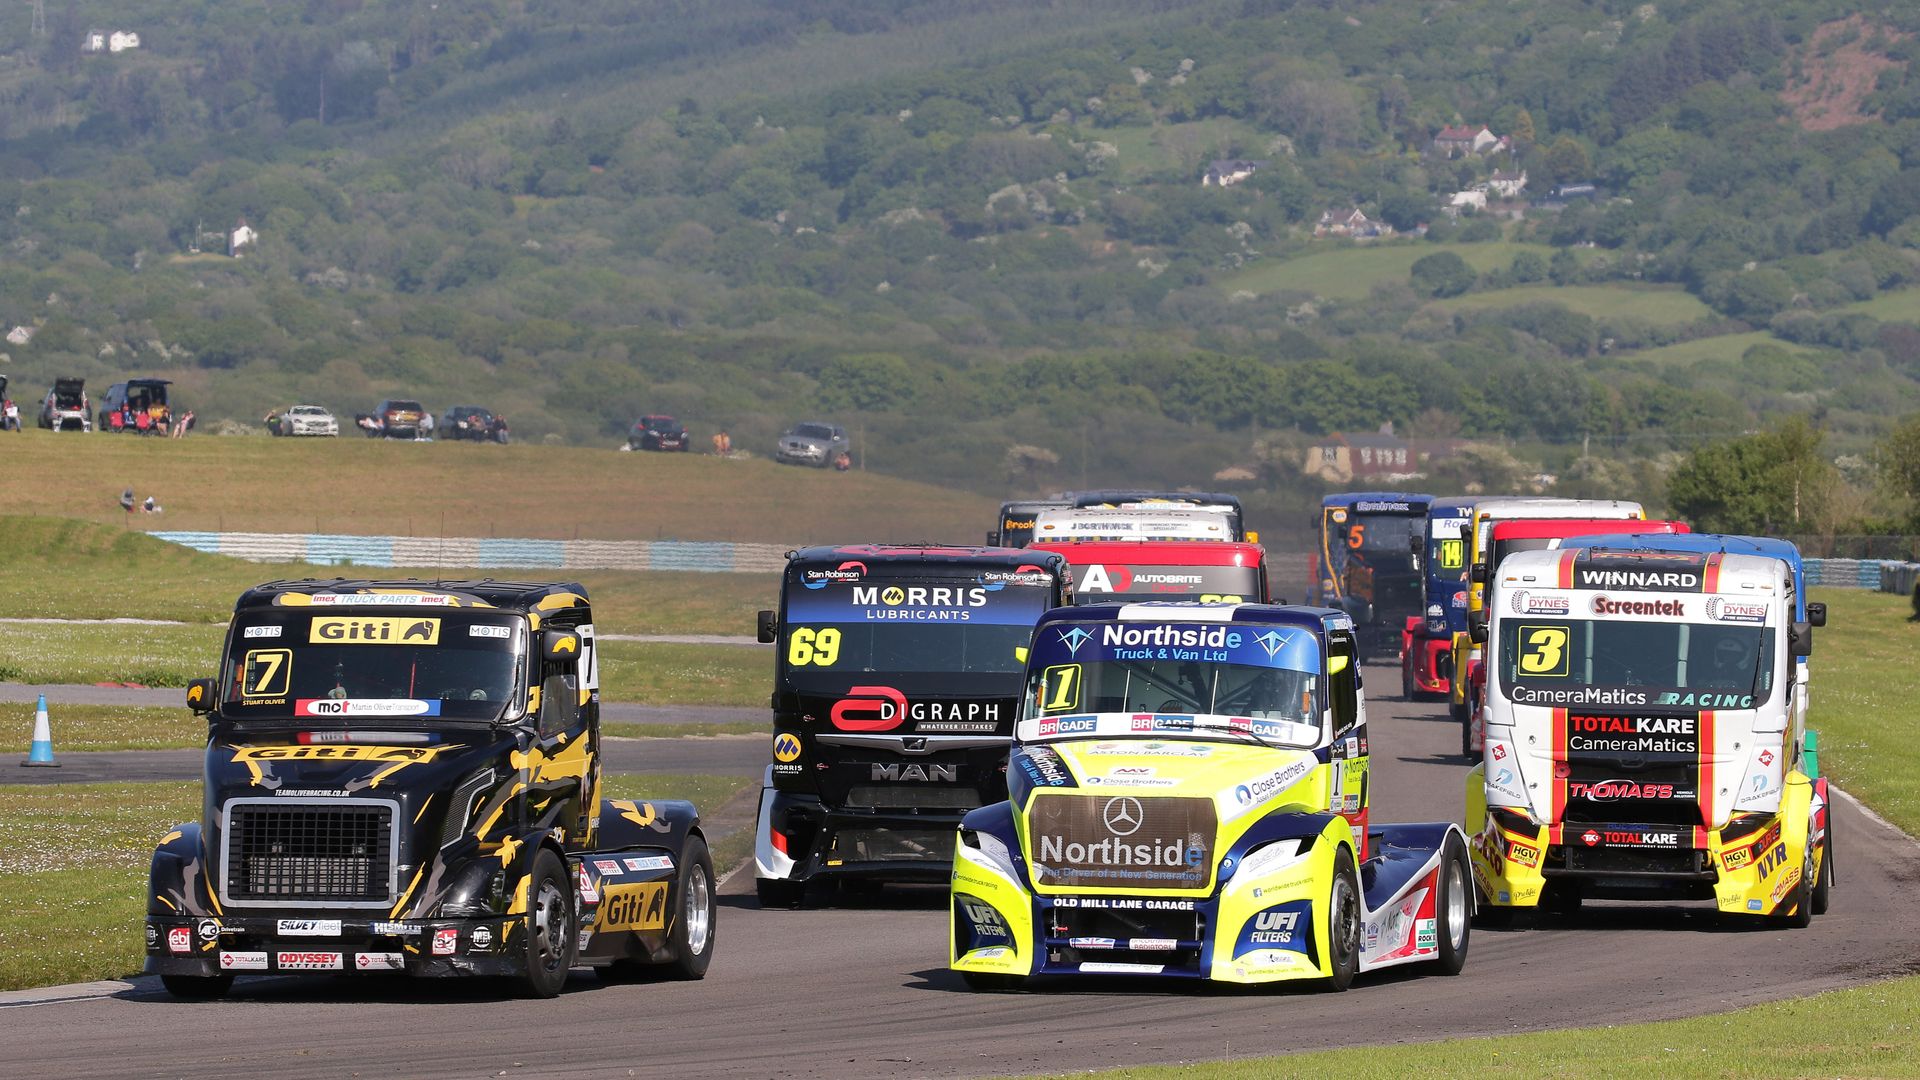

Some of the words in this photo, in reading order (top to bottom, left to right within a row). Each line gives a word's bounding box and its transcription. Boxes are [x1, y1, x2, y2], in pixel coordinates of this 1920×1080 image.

[1349, 525, 1365, 548] 5
[1444, 542, 1461, 566] 14
[808, 570, 824, 578] Stan
[825, 570, 859, 578] Robinson
[985, 572, 1001, 580] Stan
[1002, 573, 1038, 581] Robinson
[1133, 575, 1202, 584] AUTOBRITE
[1582, 571, 1697, 587] WINNARD
[313, 595, 337, 604] imex
[341, 595, 377, 604] TRUCK
[380, 595, 418, 604] PARTS
[421, 596, 446, 605] imex
[1529, 599, 1569, 608] DYNES
[1595, 597, 1684, 616] Screentek
[866, 610, 970, 620] LUBRICANTS
[1723, 607, 1765, 616] DYNES
[245, 627, 281, 636] MOTIS
[319, 622, 390, 641] Giti
[471, 626, 510, 637] MOTIS
[1103, 624, 1242, 649] Northside
[788, 627, 842, 666] 69
[1520, 629, 1567, 672] 3
[1114, 648, 1154, 660] Truck
[1157, 648, 1168, 659] &
[1172, 648, 1199, 661] Van
[1203, 649, 1228, 662] Ltd
[254, 653, 284, 691] 7
[1046, 667, 1071, 709] 1
[1512, 686, 1646, 705] CameraMatics
[1660, 692, 1753, 708] RACING
[352, 703, 373, 711] Martin
[880, 703, 998, 720] DIGRAPH
[1040, 718, 1096, 734] BRIGADE
[1132, 719, 1193, 731] BRIGADE
[1571, 717, 1695, 734] TOTALKARE
[1570, 736, 1696, 753] CameraMatics
[247, 747, 362, 758] Giti
[871, 763, 957, 782] MAN
[1251, 777, 1276, 796] Close
[1274, 761, 1306, 785] Brothers
[1333, 762, 1340, 796] 1
[275, 789, 350, 797] TEAMOLIVERRACING.CO.UK
[1570, 783, 1674, 798] THOMAS'S
[1603, 832, 1677, 844] TOTALKARE
[1041, 836, 1203, 868] Northside
[1513, 845, 1535, 859] HGV
[1515, 854, 1534, 863] DIRECT
[1725, 849, 1747, 863] HGV
[1730, 858, 1747, 867] DIRECT
[1757, 841, 1788, 883] NYR
[1063, 867, 1096, 877] Driver
[1097, 868, 1109, 877] of
[1120, 869, 1143, 878] New
[1145, 870, 1203, 881] Generation
[607, 892, 644, 926] Giti
[1053, 898, 1078, 908] OLD
[1081, 899, 1109, 908] MILL
[1112, 900, 1142, 909] LANE
[1145, 901, 1194, 911] GARAGE
[965, 904, 1000, 924] UFI
[1255, 911, 1300, 930] UFI
[318, 920, 340, 931] fleet
[975, 924, 1006, 937] FILTERS
[168, 928, 190, 945] febi
[279, 953, 339, 963] ODYSSEY
